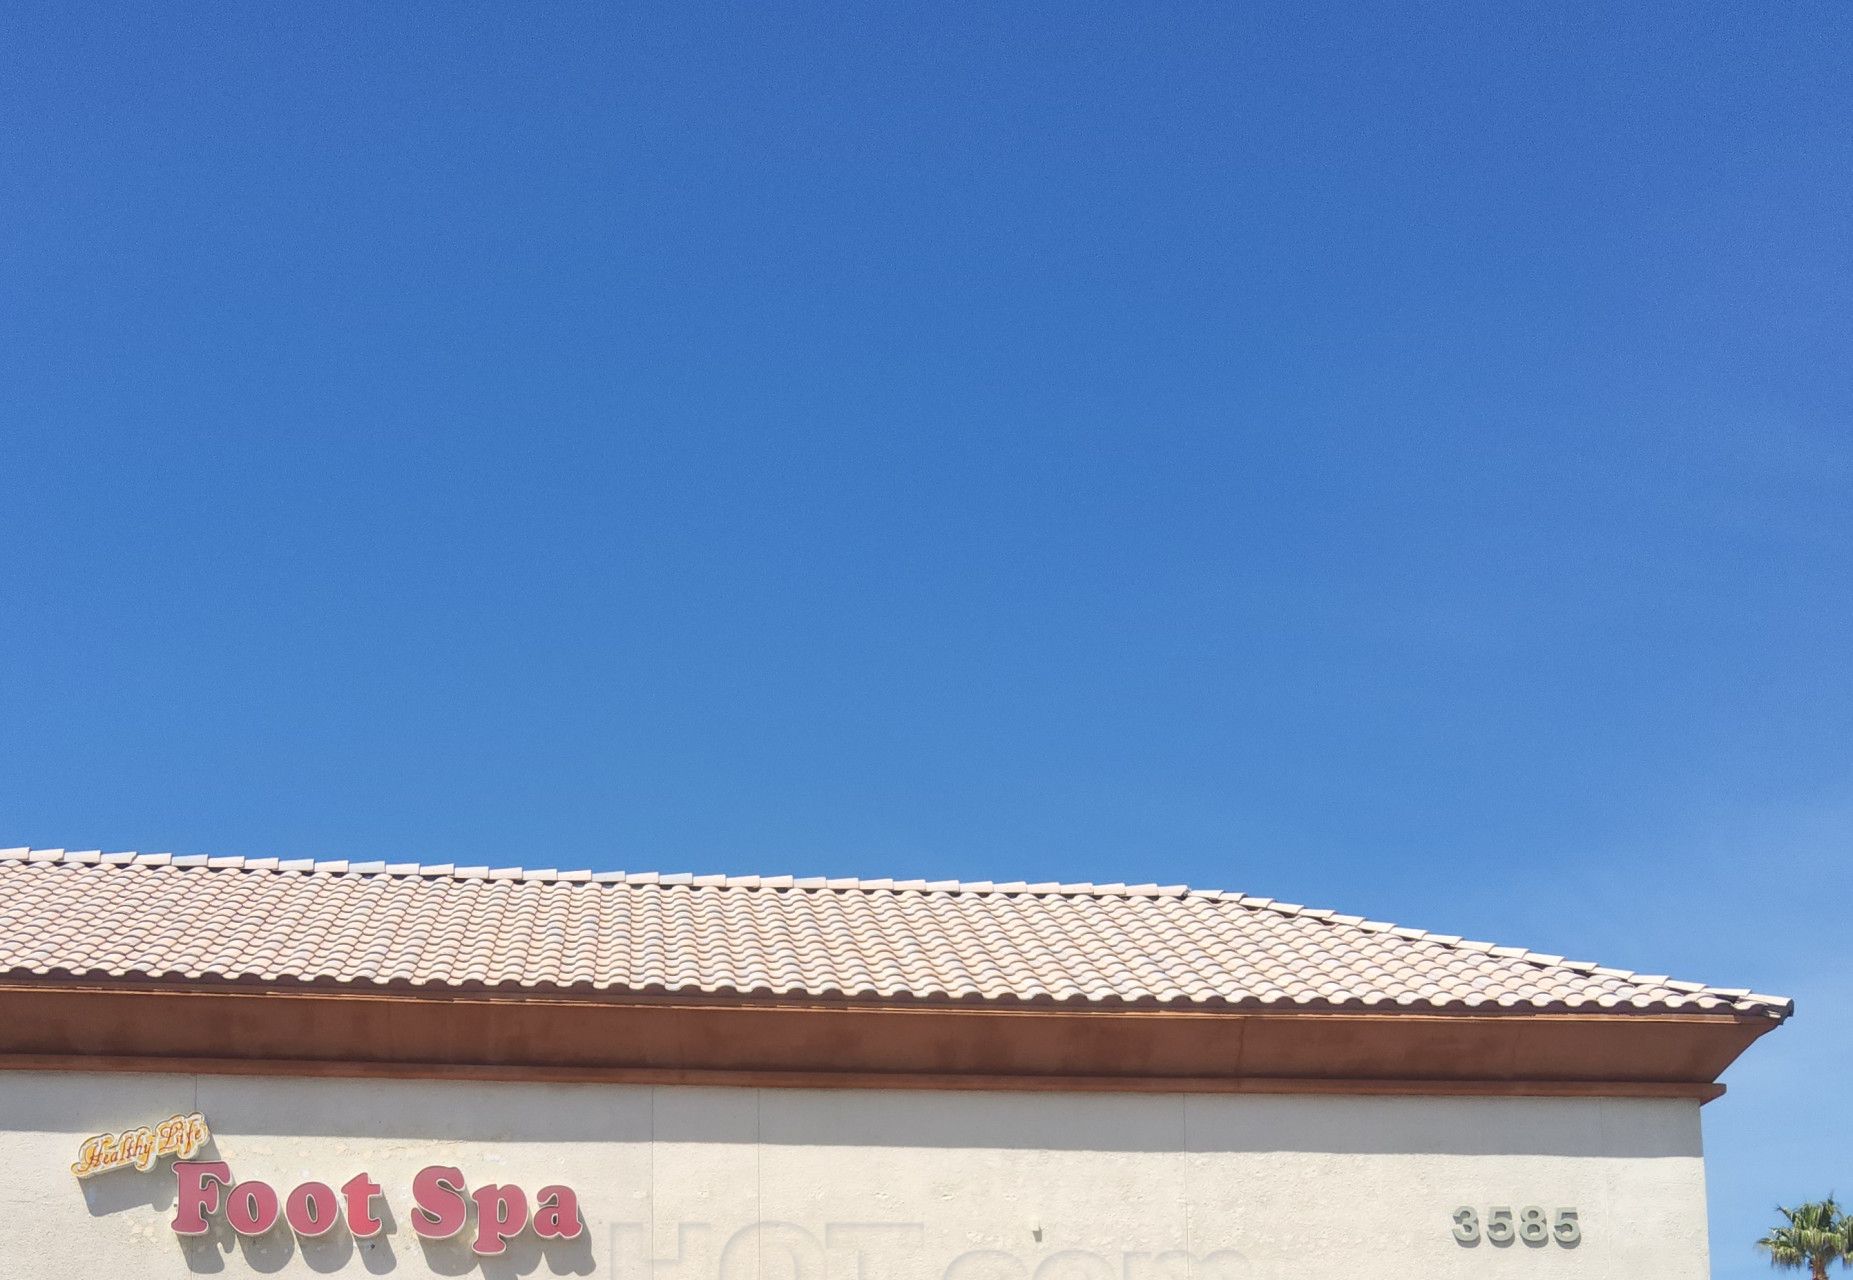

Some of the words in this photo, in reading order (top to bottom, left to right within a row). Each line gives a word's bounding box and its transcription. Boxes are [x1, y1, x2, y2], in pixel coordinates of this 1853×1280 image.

[76, 1130, 153, 1174] Healthy
[158, 1117, 202, 1156] Life
[171, 1160, 384, 1237] Foot
[411, 1164, 583, 1256] Spa
[1451, 1205, 1581, 1245] 3585
